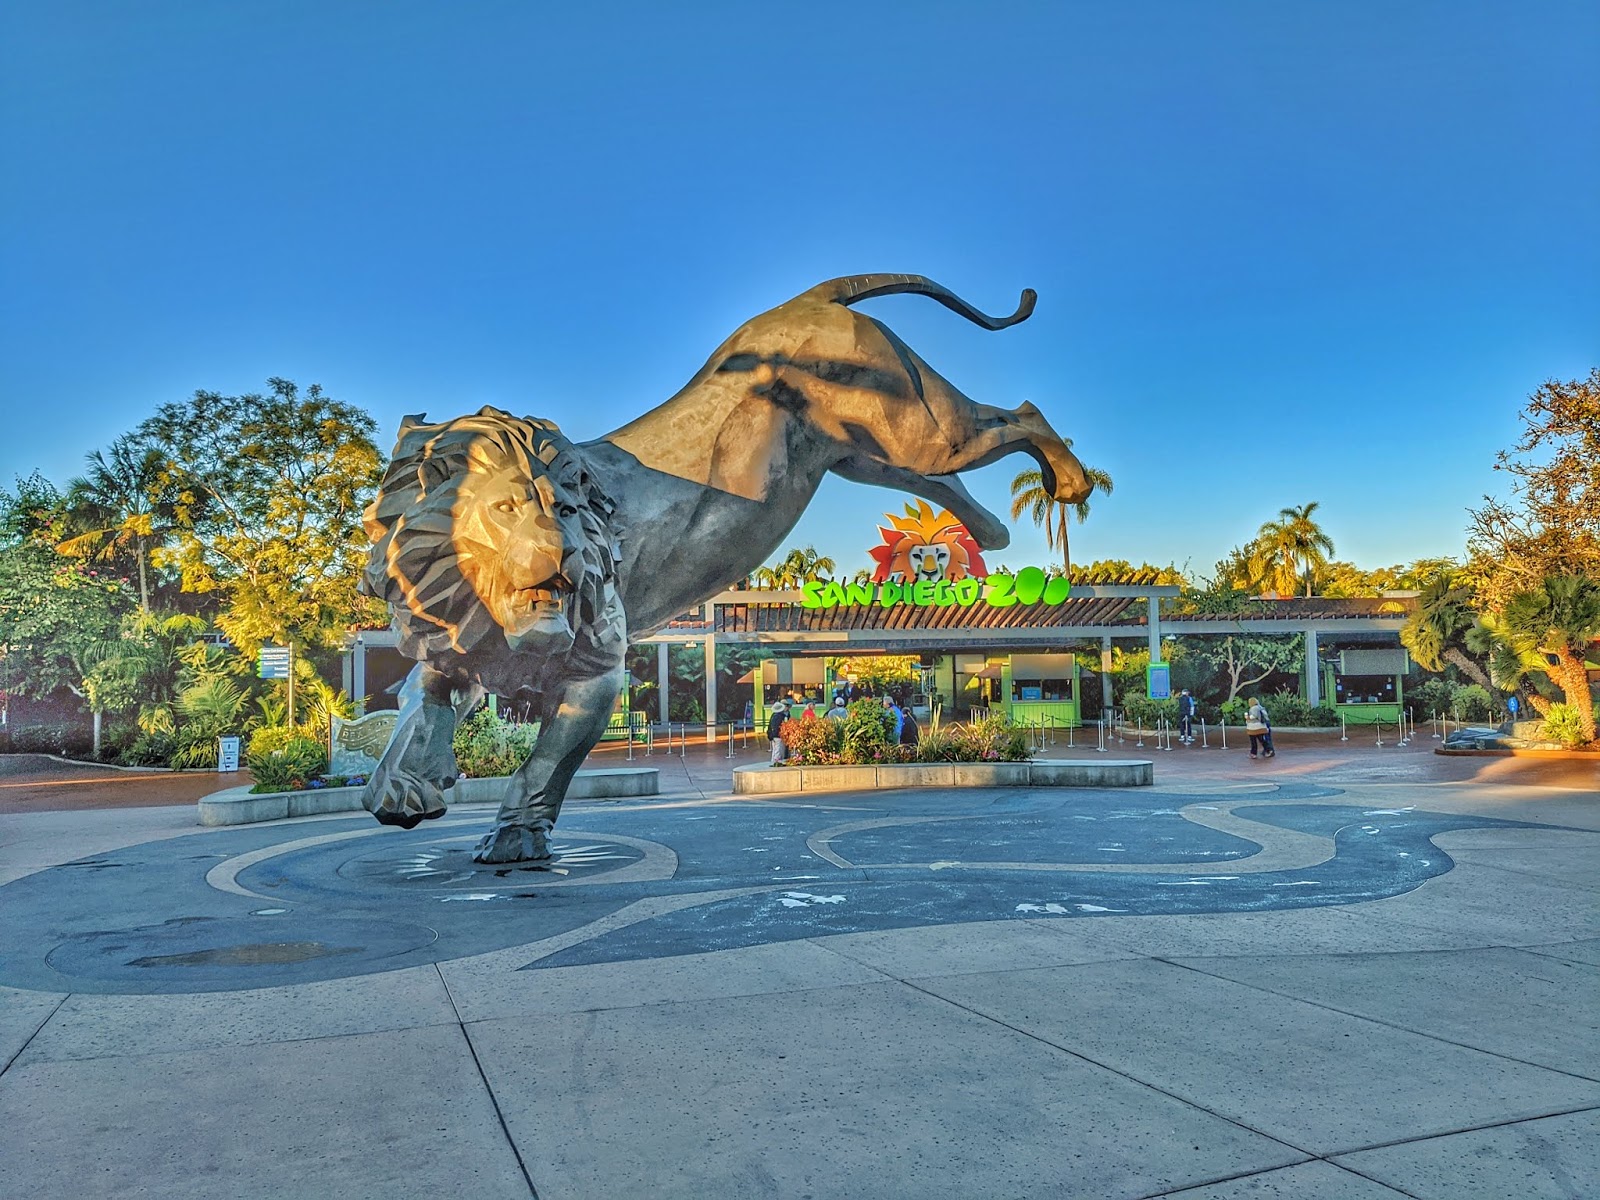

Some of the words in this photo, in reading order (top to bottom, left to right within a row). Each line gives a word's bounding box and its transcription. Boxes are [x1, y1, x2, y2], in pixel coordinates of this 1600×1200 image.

[801, 580, 874, 609] SAN
[880, 579, 979, 608] DIEGO
[985, 566, 1071, 607] ZOO
